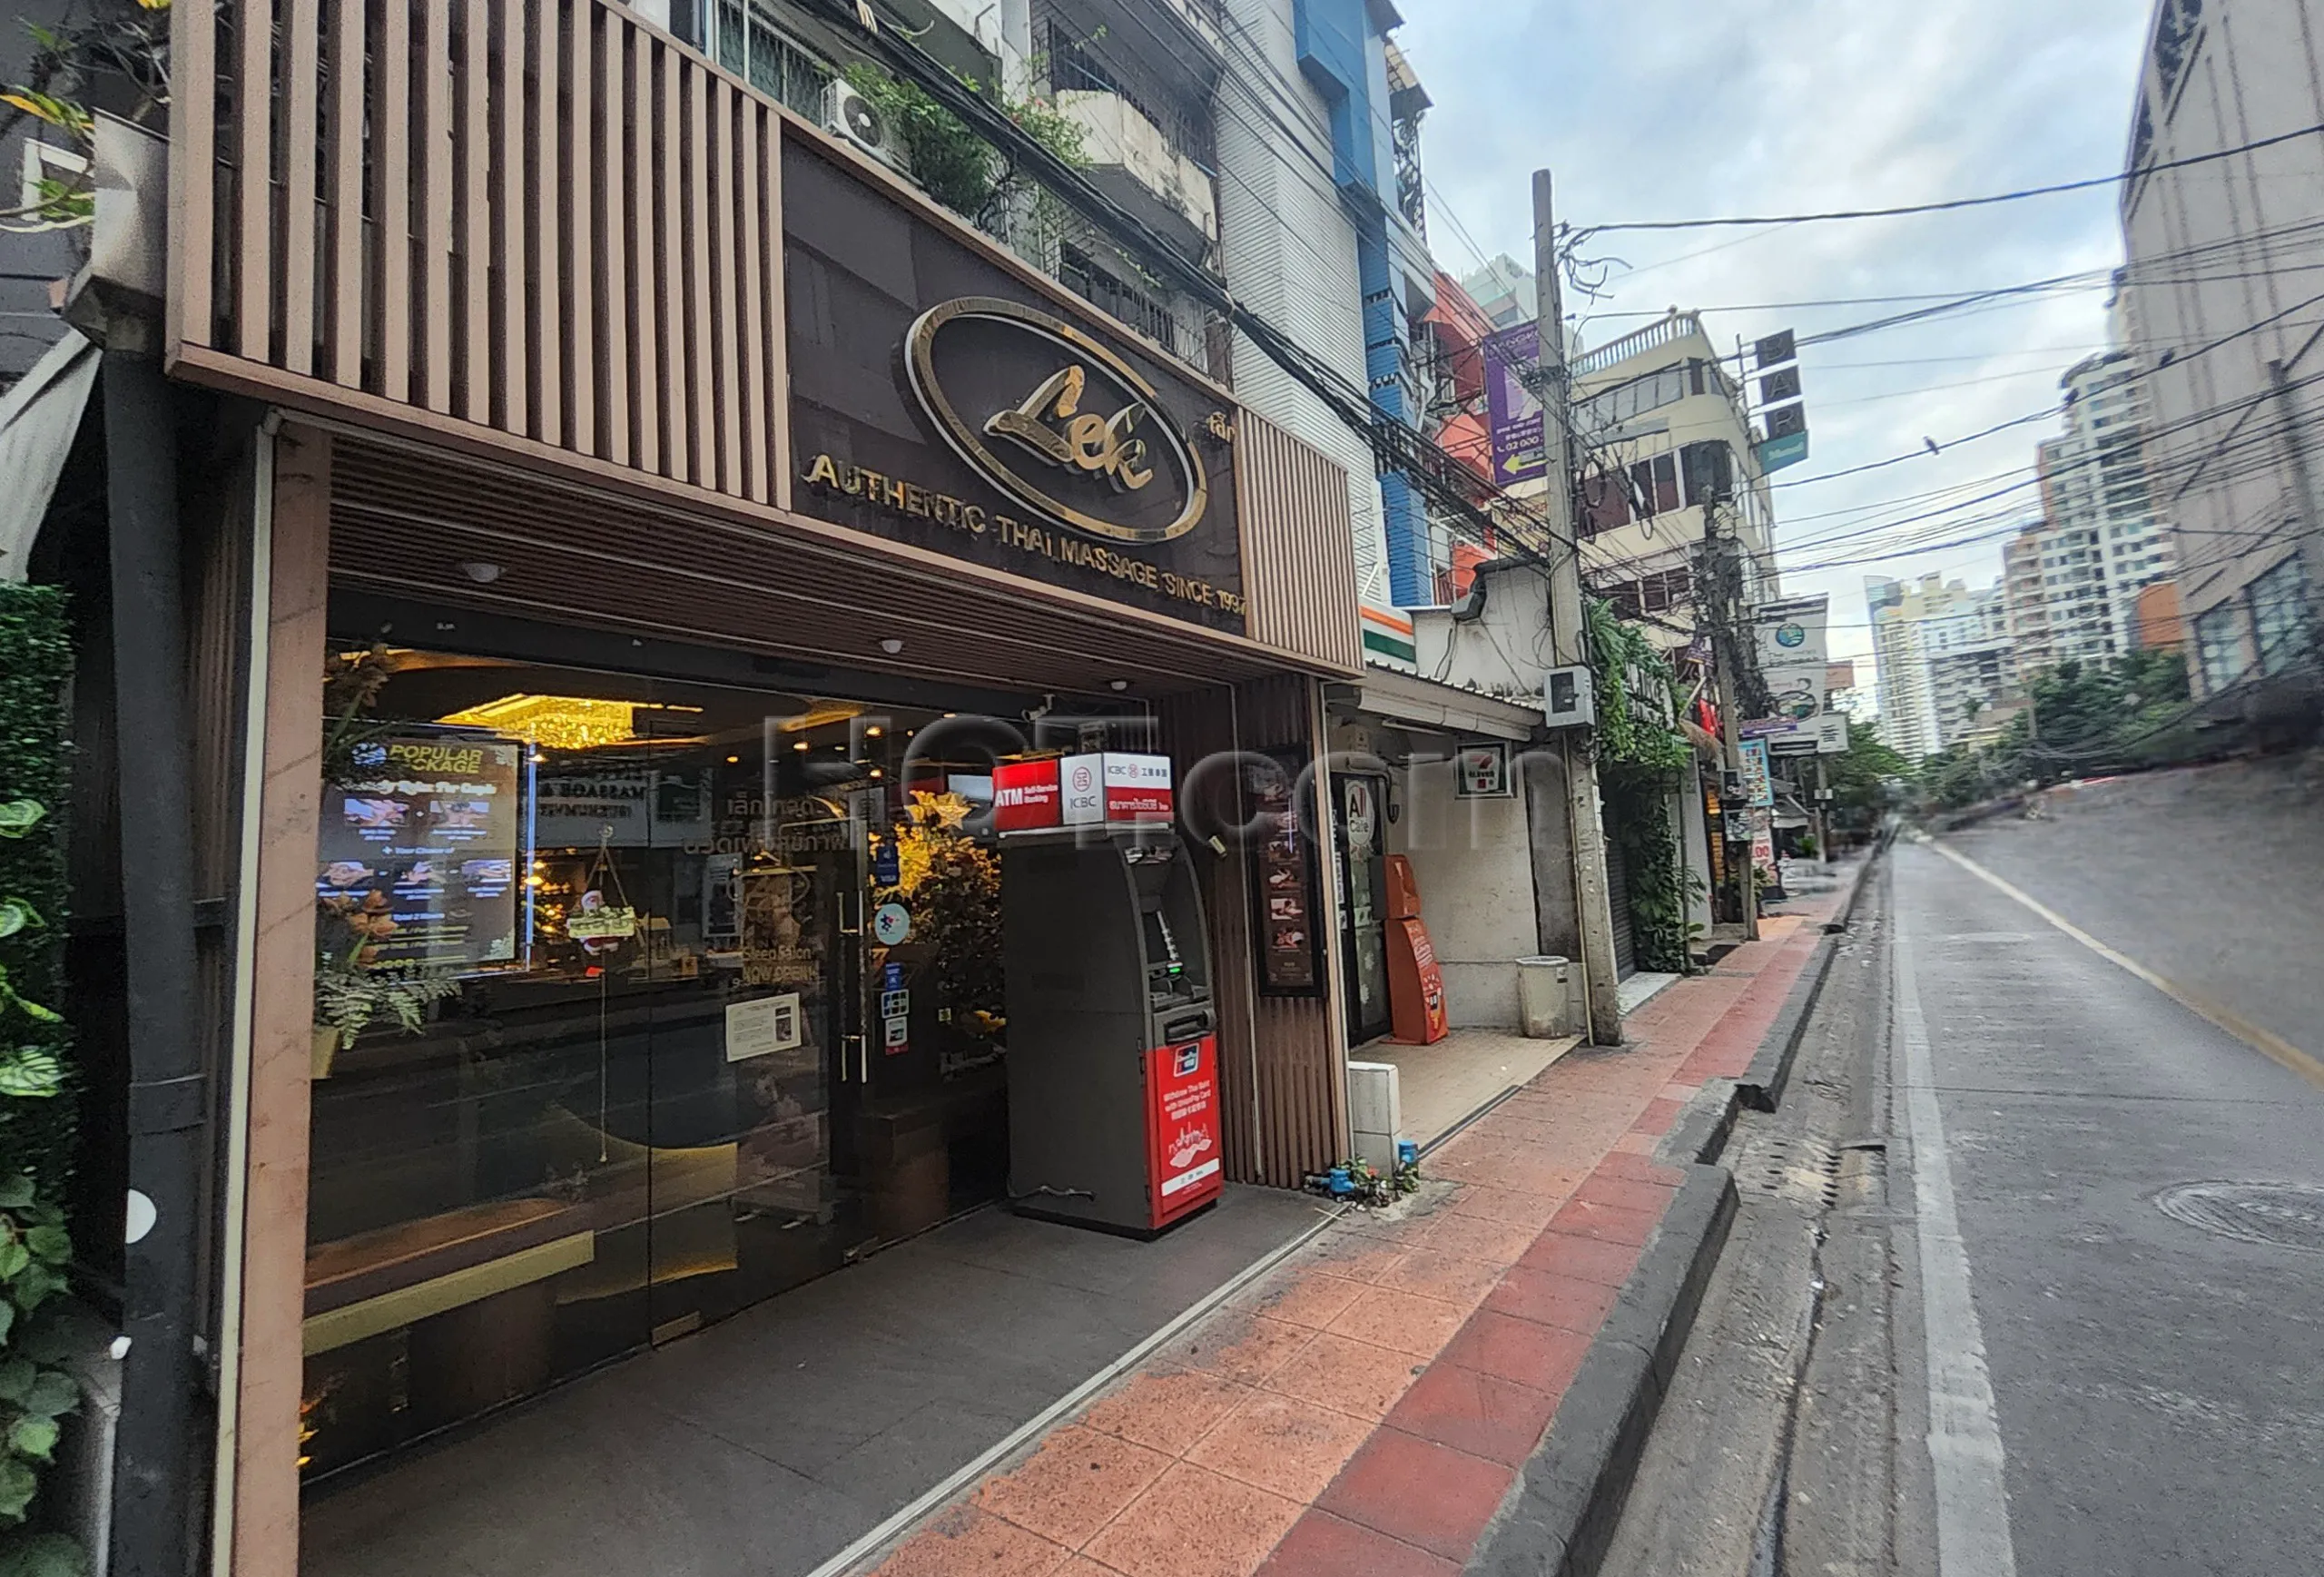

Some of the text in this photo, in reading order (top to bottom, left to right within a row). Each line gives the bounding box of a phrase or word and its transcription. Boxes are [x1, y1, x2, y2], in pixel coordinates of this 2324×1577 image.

[983, 365, 1153, 489] Lek
[801, 454, 987, 533] AUTHENTIC
[996, 515, 1052, 557] THAI
[1060, 537, 1158, 589] MASSAGE
[1161, 572, 1214, 606] SINCE
[389, 744, 484, 763] POPULAR
[405, 757, 480, 775] CKAGE
[1108, 764, 1127, 775] ICBC
[994, 787, 1023, 807] ATM
[1069, 795, 1097, 810] ICBC
[1349, 787, 1367, 817] All
